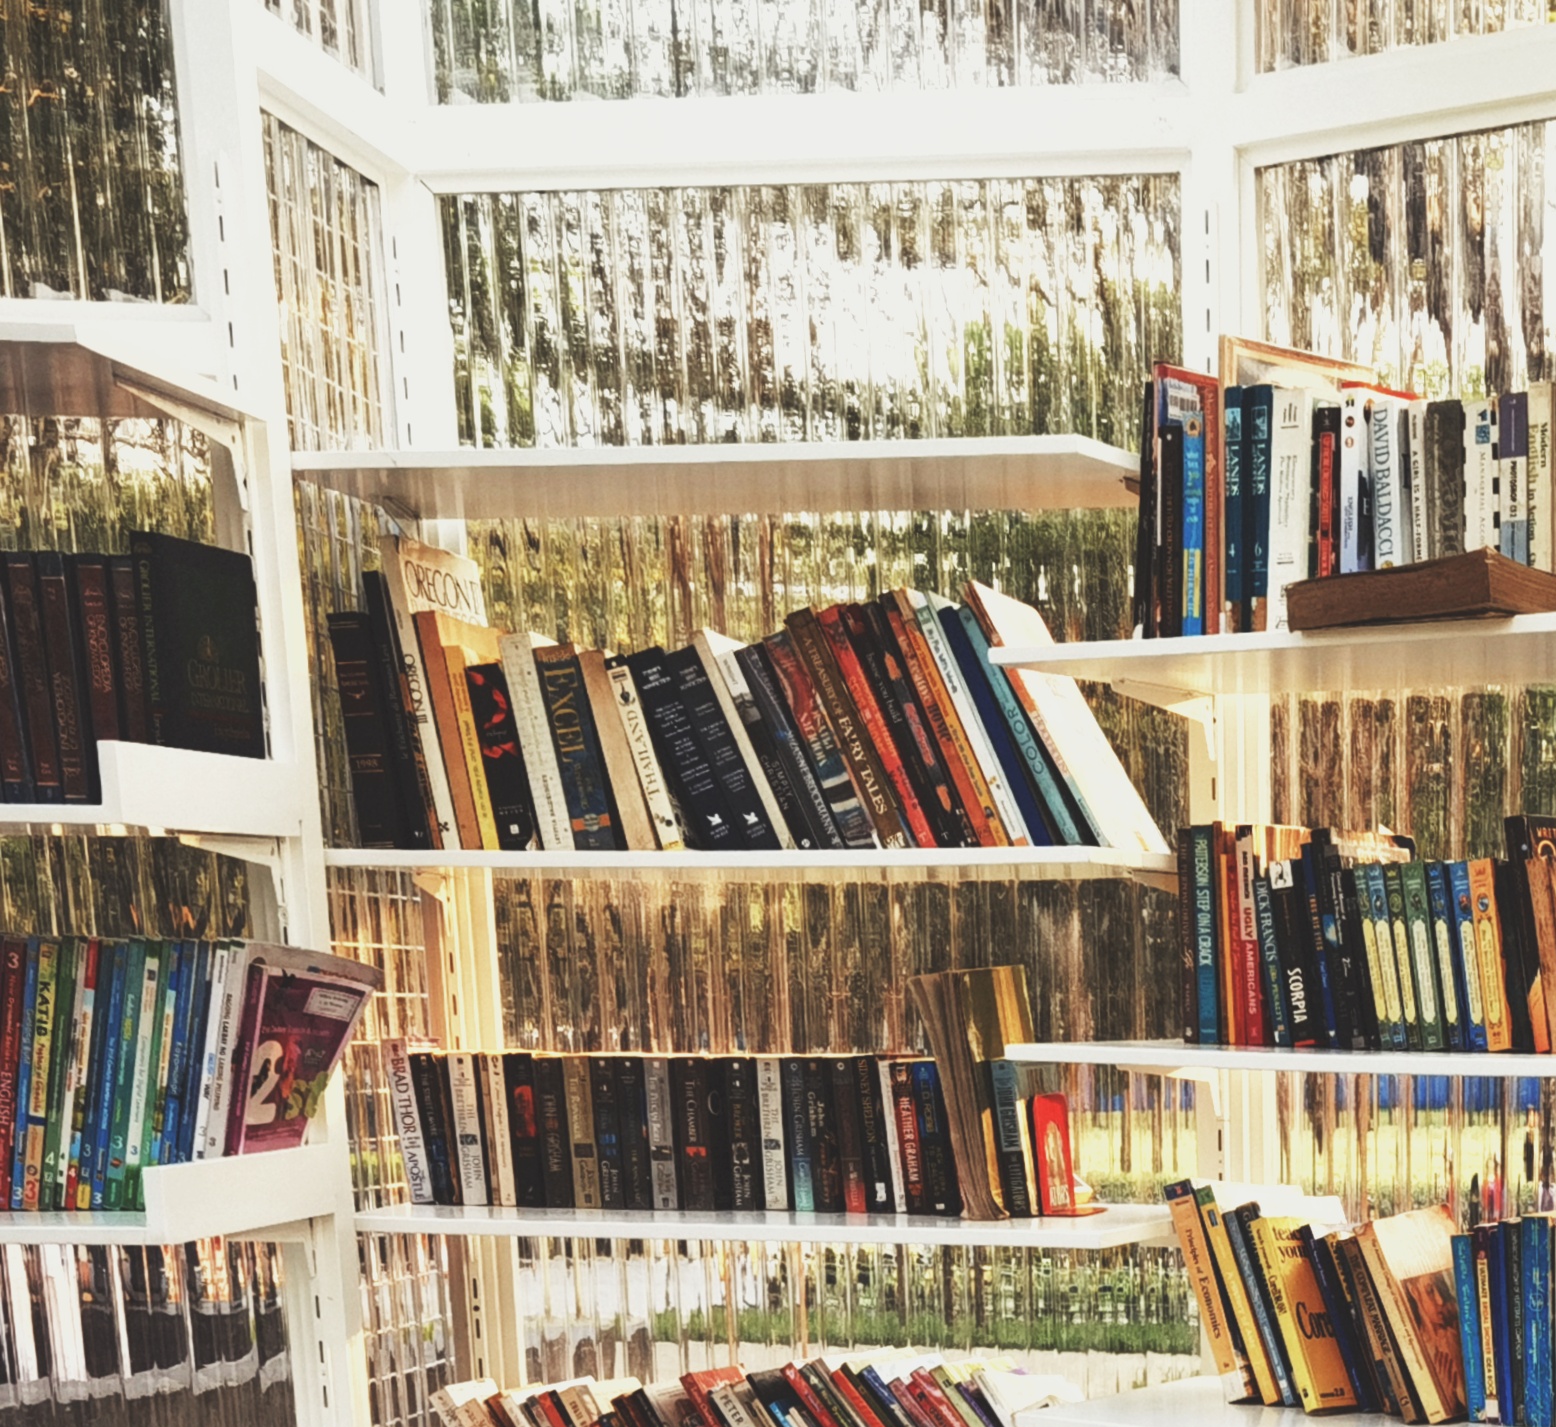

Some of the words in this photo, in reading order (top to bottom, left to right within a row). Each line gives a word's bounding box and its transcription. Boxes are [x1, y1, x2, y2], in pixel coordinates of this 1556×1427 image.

[1372, 408, 1391, 465] DAVID
[1528, 424, 1540, 484] English
[1540, 422, 1549, 468] Modern
[1230, 445, 1239, 497] LANDS
[1256, 443, 1266, 495] LANDS
[1375, 469, 1393, 557] BALDACCI
[1243, 906, 1255, 939] UGLY
[1255, 881, 1271, 910] DICK
[1260, 912, 1276, 961] FRANCIS
[1245, 942, 1258, 1015] AMERICANS
[1287, 968, 1307, 1024] SCORPIA
[1199, 1276, 1222, 1340] Economics
